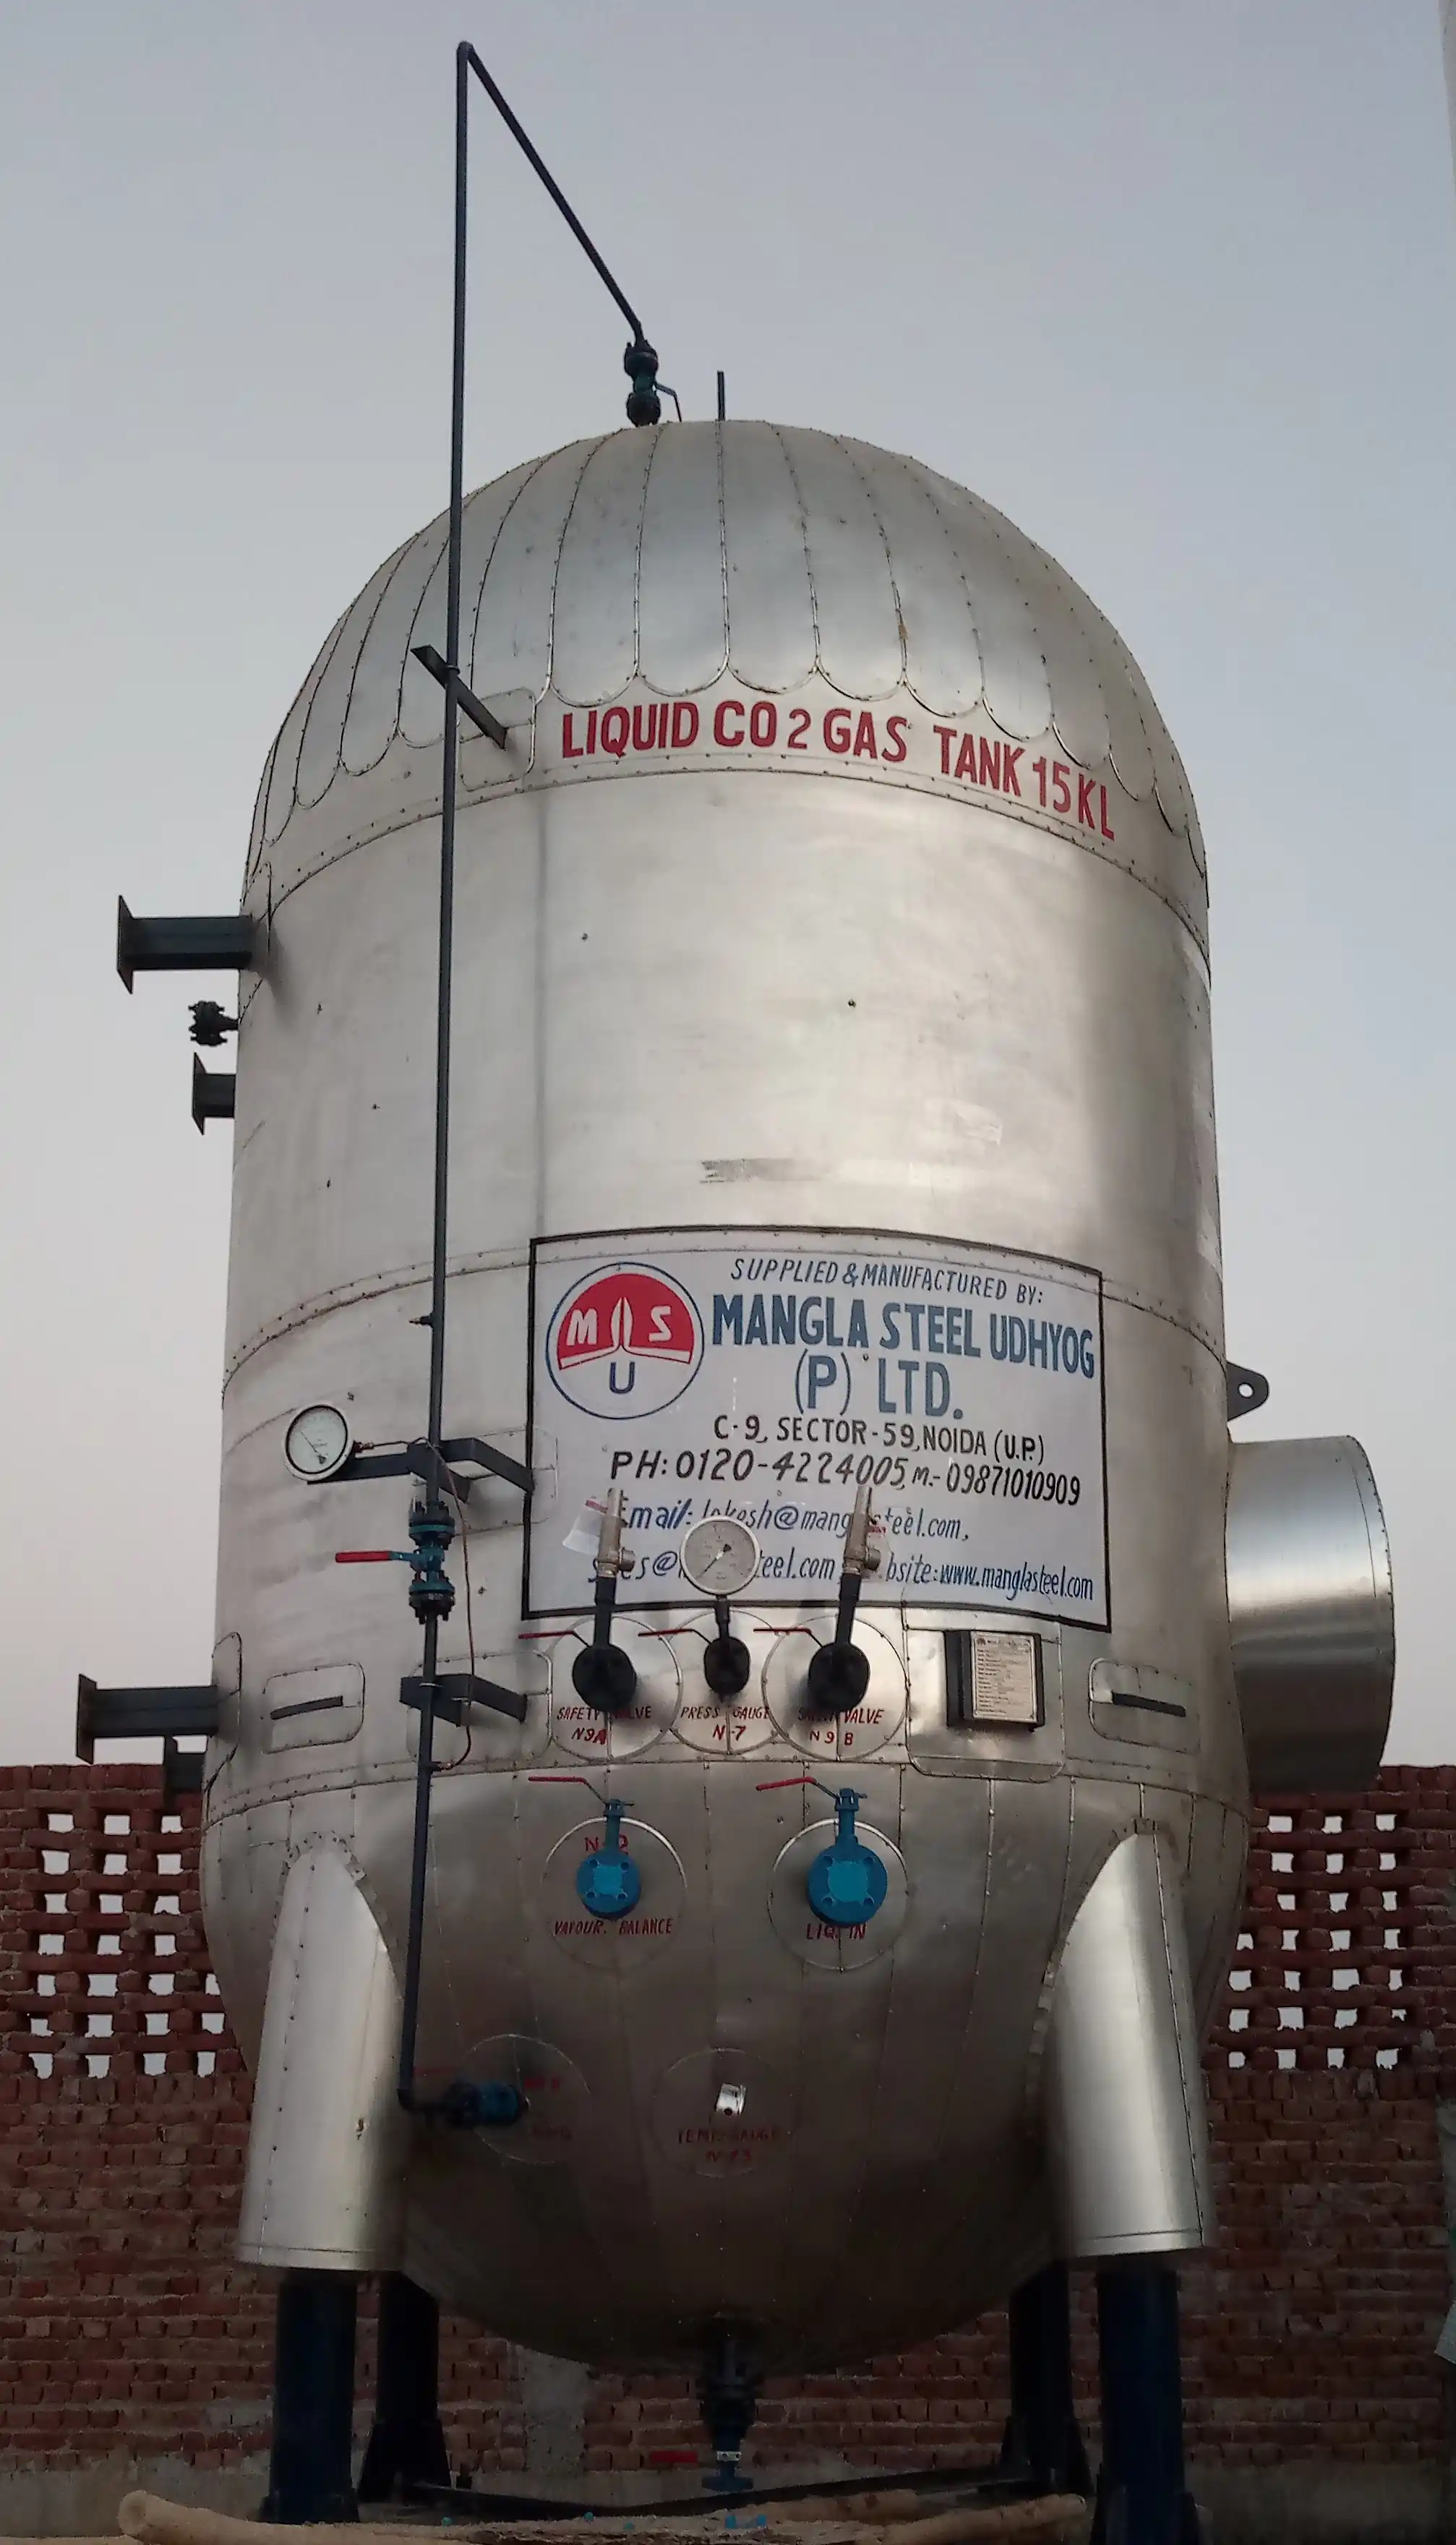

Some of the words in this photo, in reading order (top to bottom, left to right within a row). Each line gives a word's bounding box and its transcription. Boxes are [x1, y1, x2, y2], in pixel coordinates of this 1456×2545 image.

[562, 701, 699, 758] LIQUID
[823, 708, 909, 764] GAS
[933, 724, 1024, 797] TANK
[731, 1258, 838, 1283] SUPPLIED
[1016, 1283, 1043, 1306] BY:
[713, 1294, 868, 1348] MANGLA
[880, 1302, 981, 1357] STEEL
[990, 1313, 1095, 1378] UDHYOG
[796, 1348, 852, 1415] (P)
[878, 1357, 964, 1420] LTD.
[557, 1707, 600, 1721] SAFETY
[680, 1706, 720, 1719] PRESS
[844, 1708, 884, 1724] VALVE
